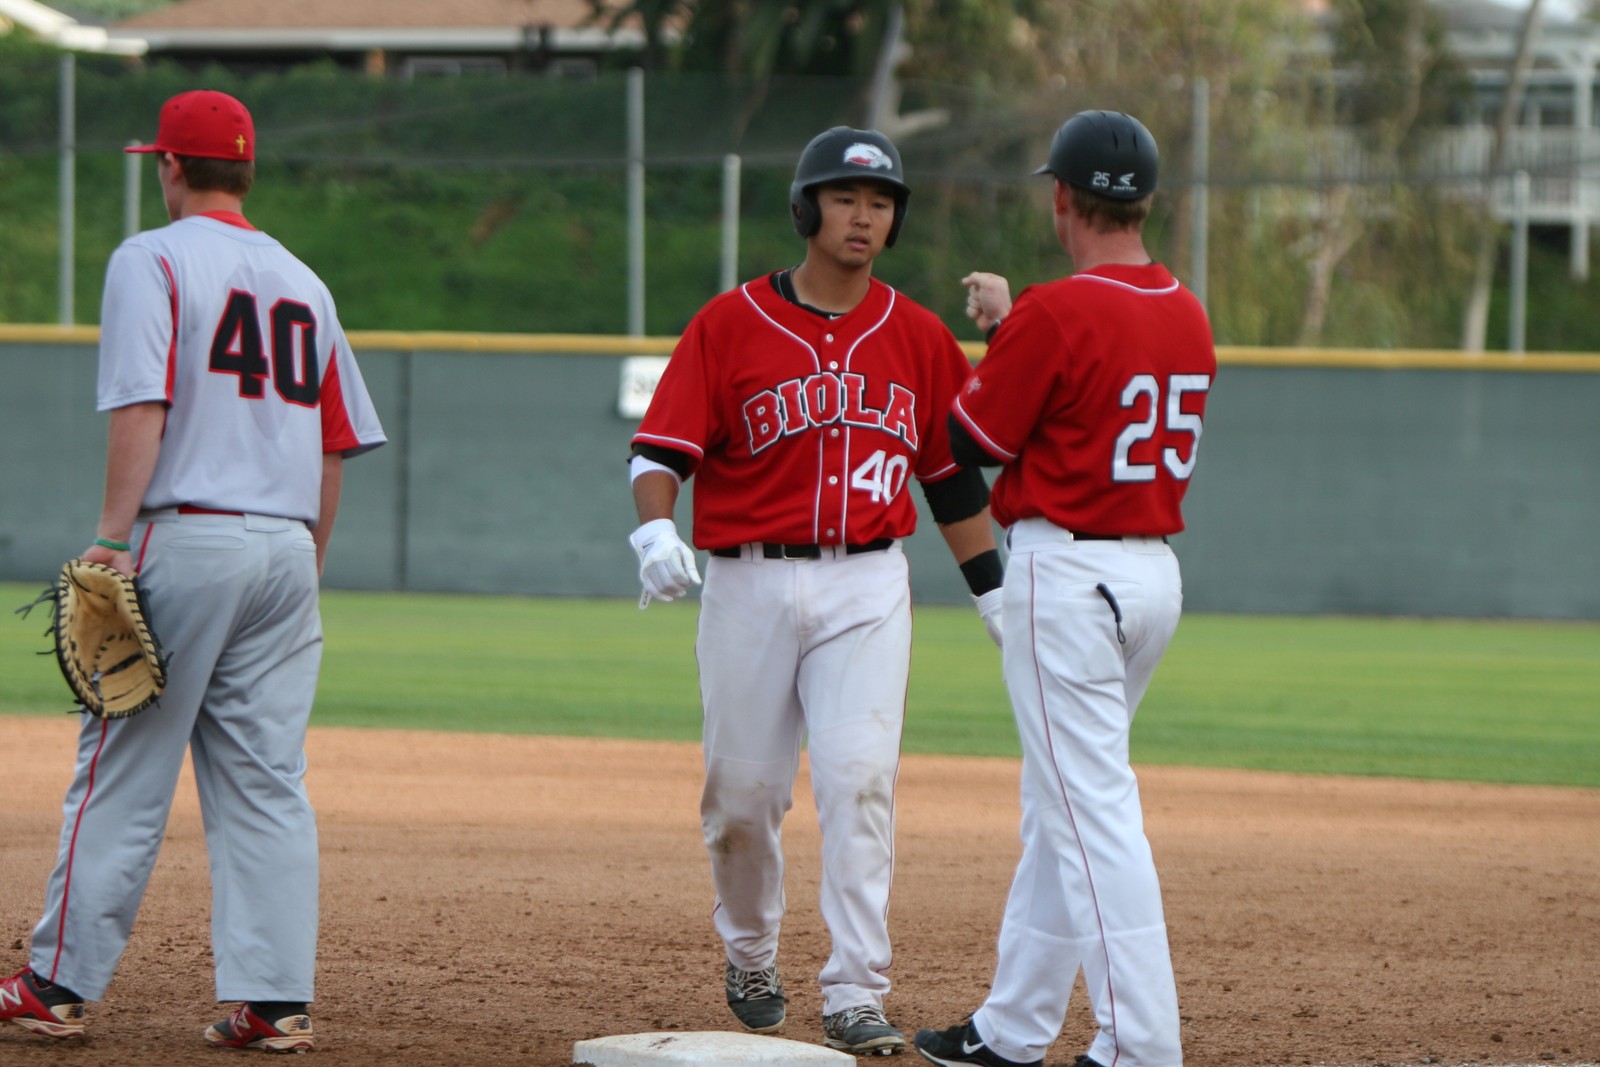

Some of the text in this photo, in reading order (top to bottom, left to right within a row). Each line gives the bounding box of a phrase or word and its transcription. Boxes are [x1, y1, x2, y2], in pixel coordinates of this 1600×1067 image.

[1093, 171, 1110, 186] 25
[208, 288, 321, 408] 40
[743, 372, 918, 454] BIOLA
[1111, 374, 1210, 482] 25
[852, 450, 909, 504] 40
